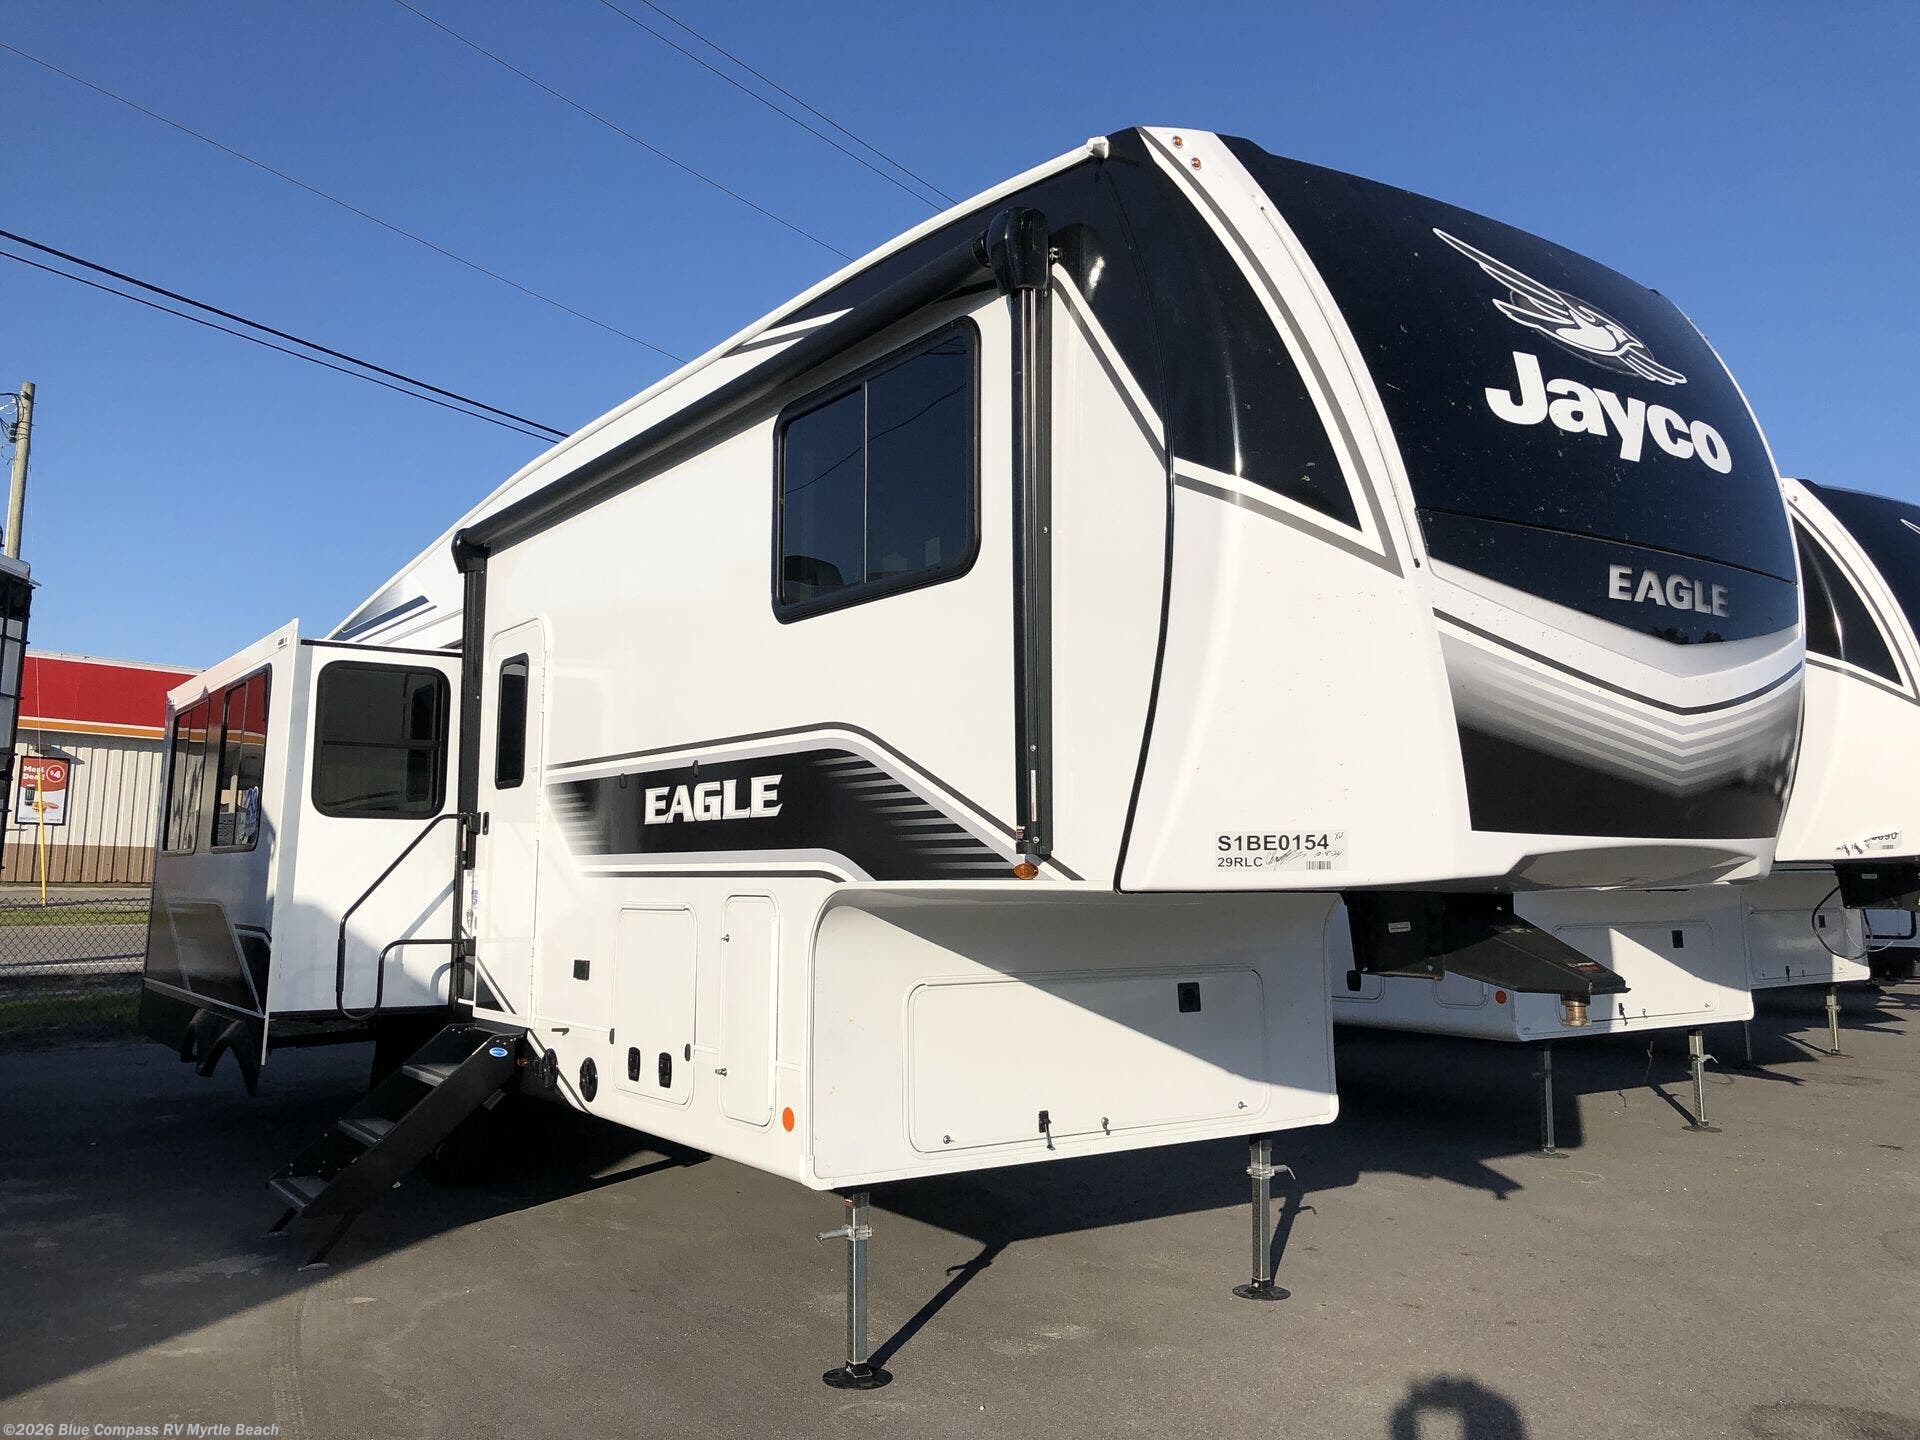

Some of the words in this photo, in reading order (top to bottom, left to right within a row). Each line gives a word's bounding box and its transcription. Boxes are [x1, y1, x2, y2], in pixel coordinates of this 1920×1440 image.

[1485, 351, 1732, 474] Jayco
[1608, 563, 1730, 618] EAGLE
[644, 774, 783, 825] EAGLE
[1217, 834, 1330, 851] S1BE0154
[1217, 857, 1263, 868] 29RLC
